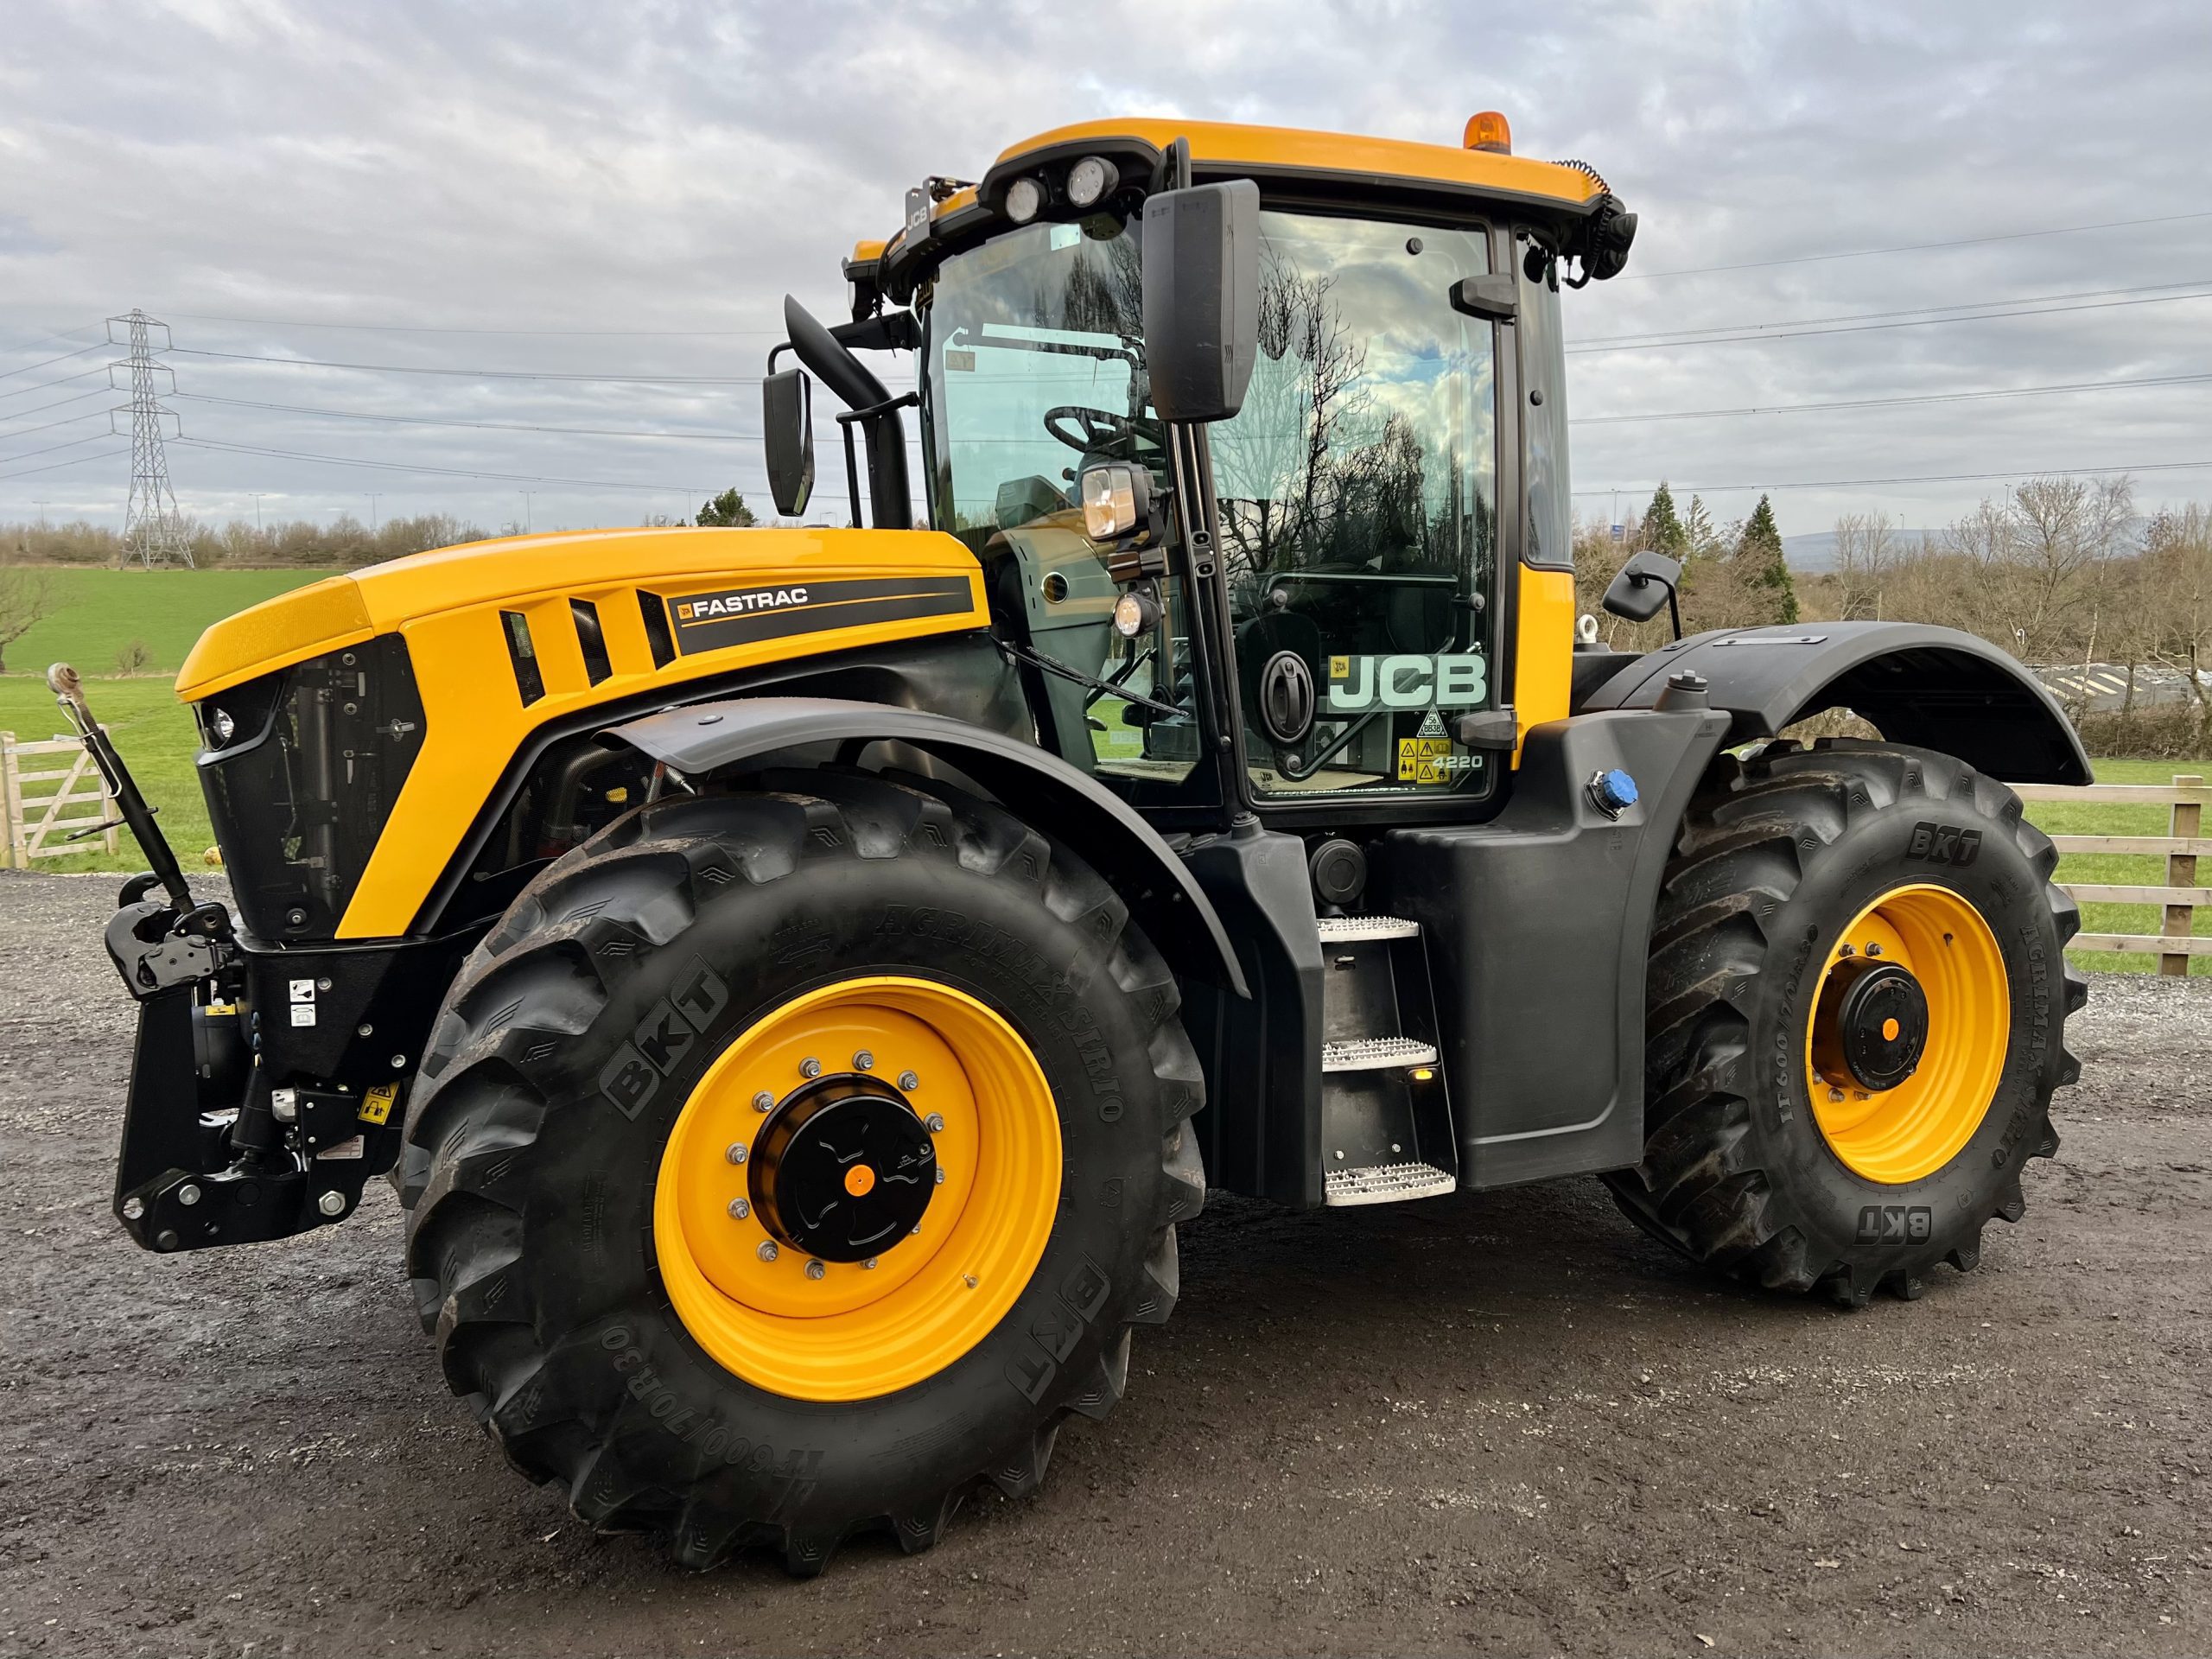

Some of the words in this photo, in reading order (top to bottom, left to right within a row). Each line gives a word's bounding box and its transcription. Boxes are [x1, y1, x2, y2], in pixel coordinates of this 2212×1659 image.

[907, 206, 928, 232] JCB
[692, 588, 809, 618] FASTRAC
[1329, 654, 1486, 708] JCB
[1432, 755, 1483, 769] 4220
[1908, 826, 1981, 863] BKT
[874, 904, 1074, 1006] AGRIMAX
[1058, 1006, 1126, 1123] SIRIO
[2019, 925, 2050, 1077] AGRIMAX
[605, 965, 718, 1114] BKT
[1856, 1209, 1930, 1241] BKT
[1014, 1261, 1106, 1396] BKT
